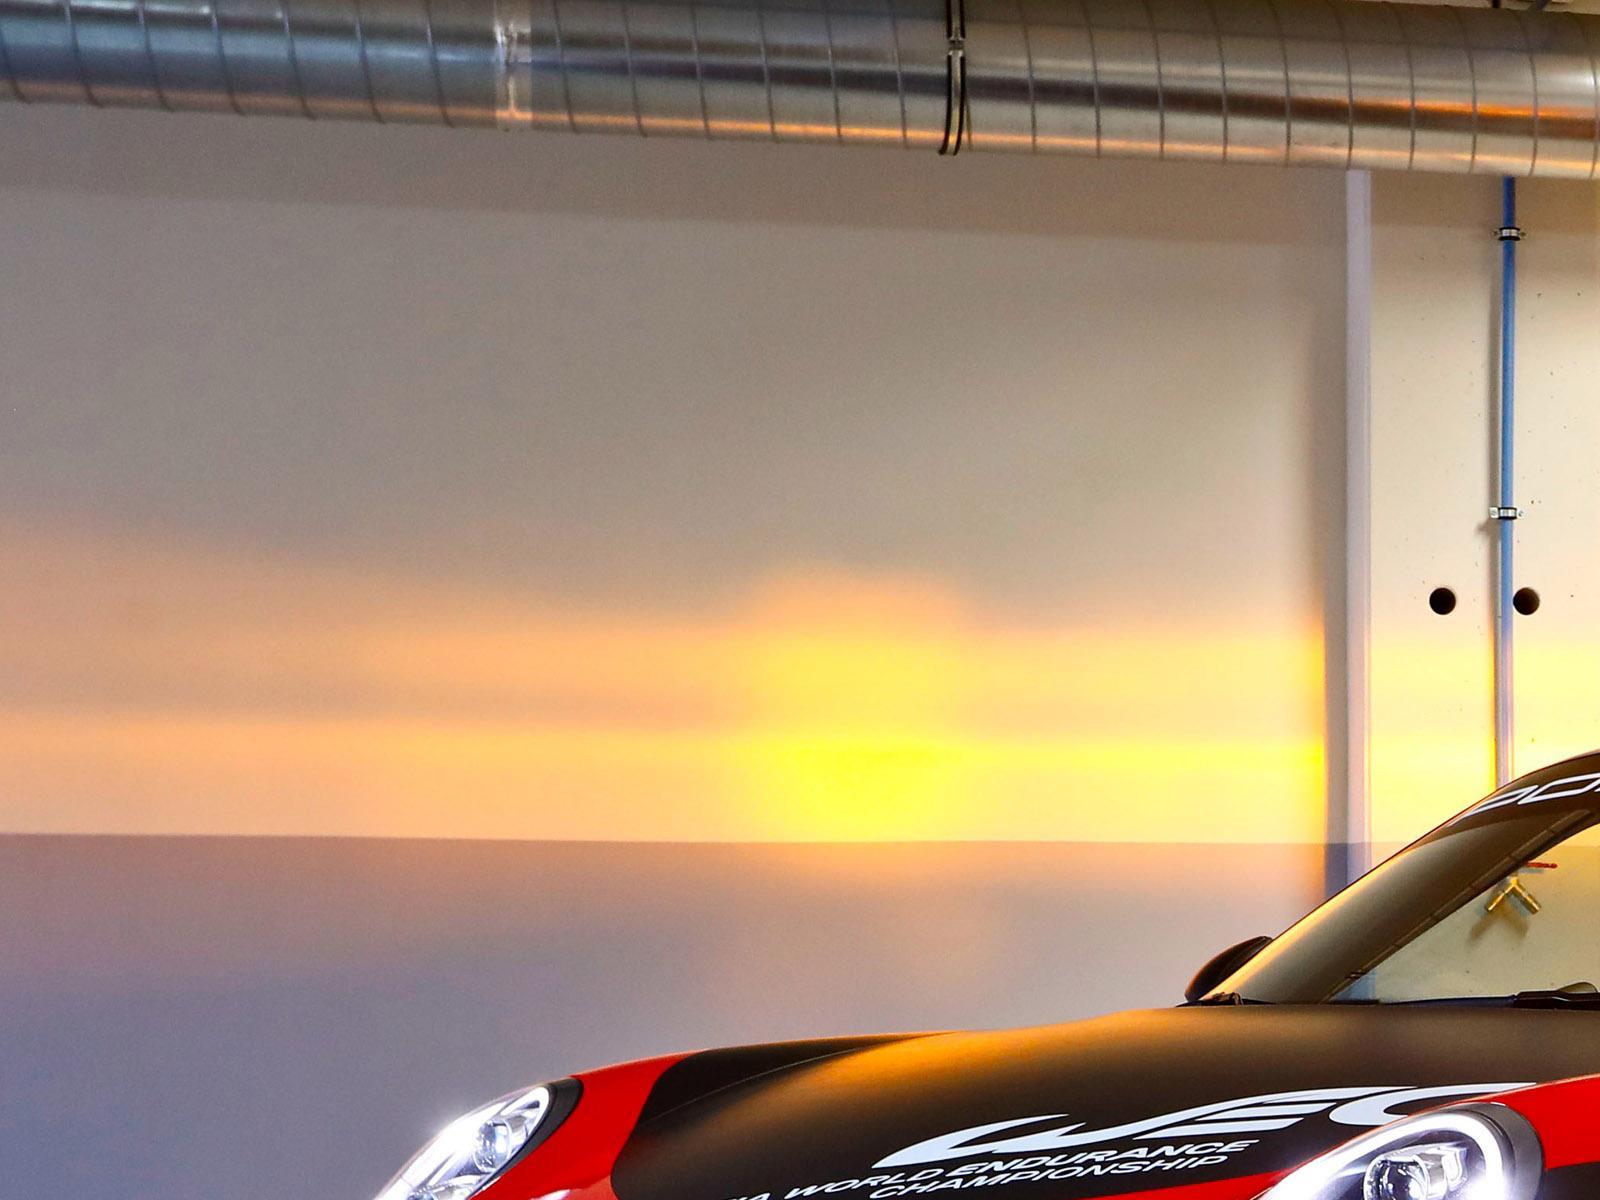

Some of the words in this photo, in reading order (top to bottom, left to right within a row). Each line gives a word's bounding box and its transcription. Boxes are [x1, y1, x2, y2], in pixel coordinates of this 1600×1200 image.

[871, 1083, 1537, 1169] WEC
[784, 1167, 944, 1200] WORLD
[945, 1139, 1260, 1177] ENDURANCE
[869, 1155, 1229, 1199] CHAMPIONSHIP
